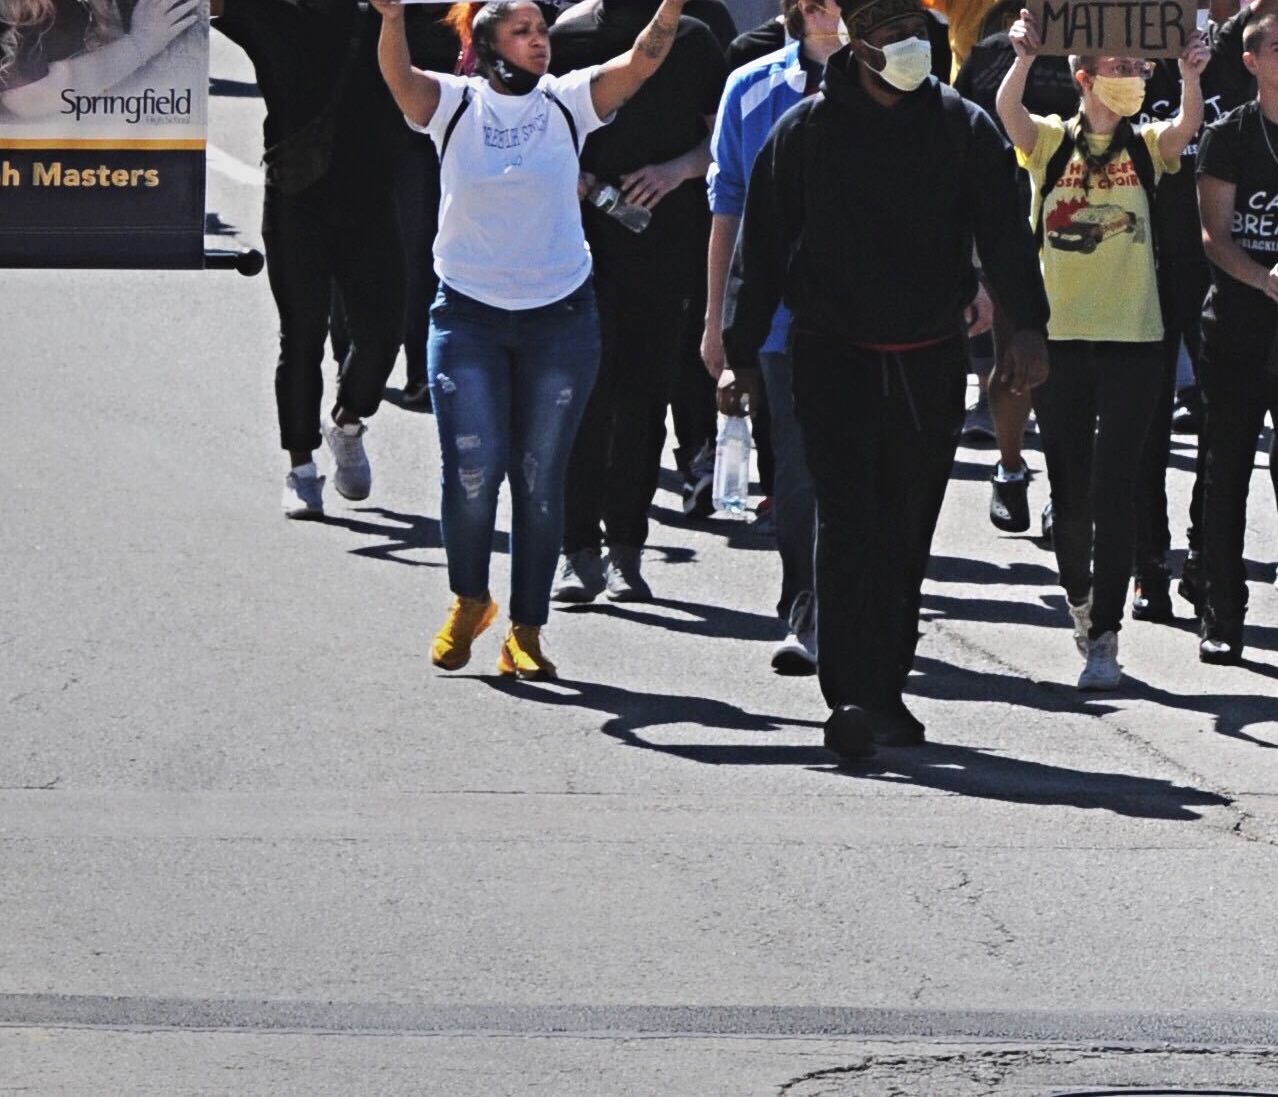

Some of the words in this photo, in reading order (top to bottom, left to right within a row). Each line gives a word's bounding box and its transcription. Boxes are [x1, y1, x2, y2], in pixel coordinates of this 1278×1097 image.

[1041, 0, 1187, 51] MATTER
[60, 88, 191, 124] Springfield
[1, 160, 20, 187] h
[32, 160, 160, 188] Masters
